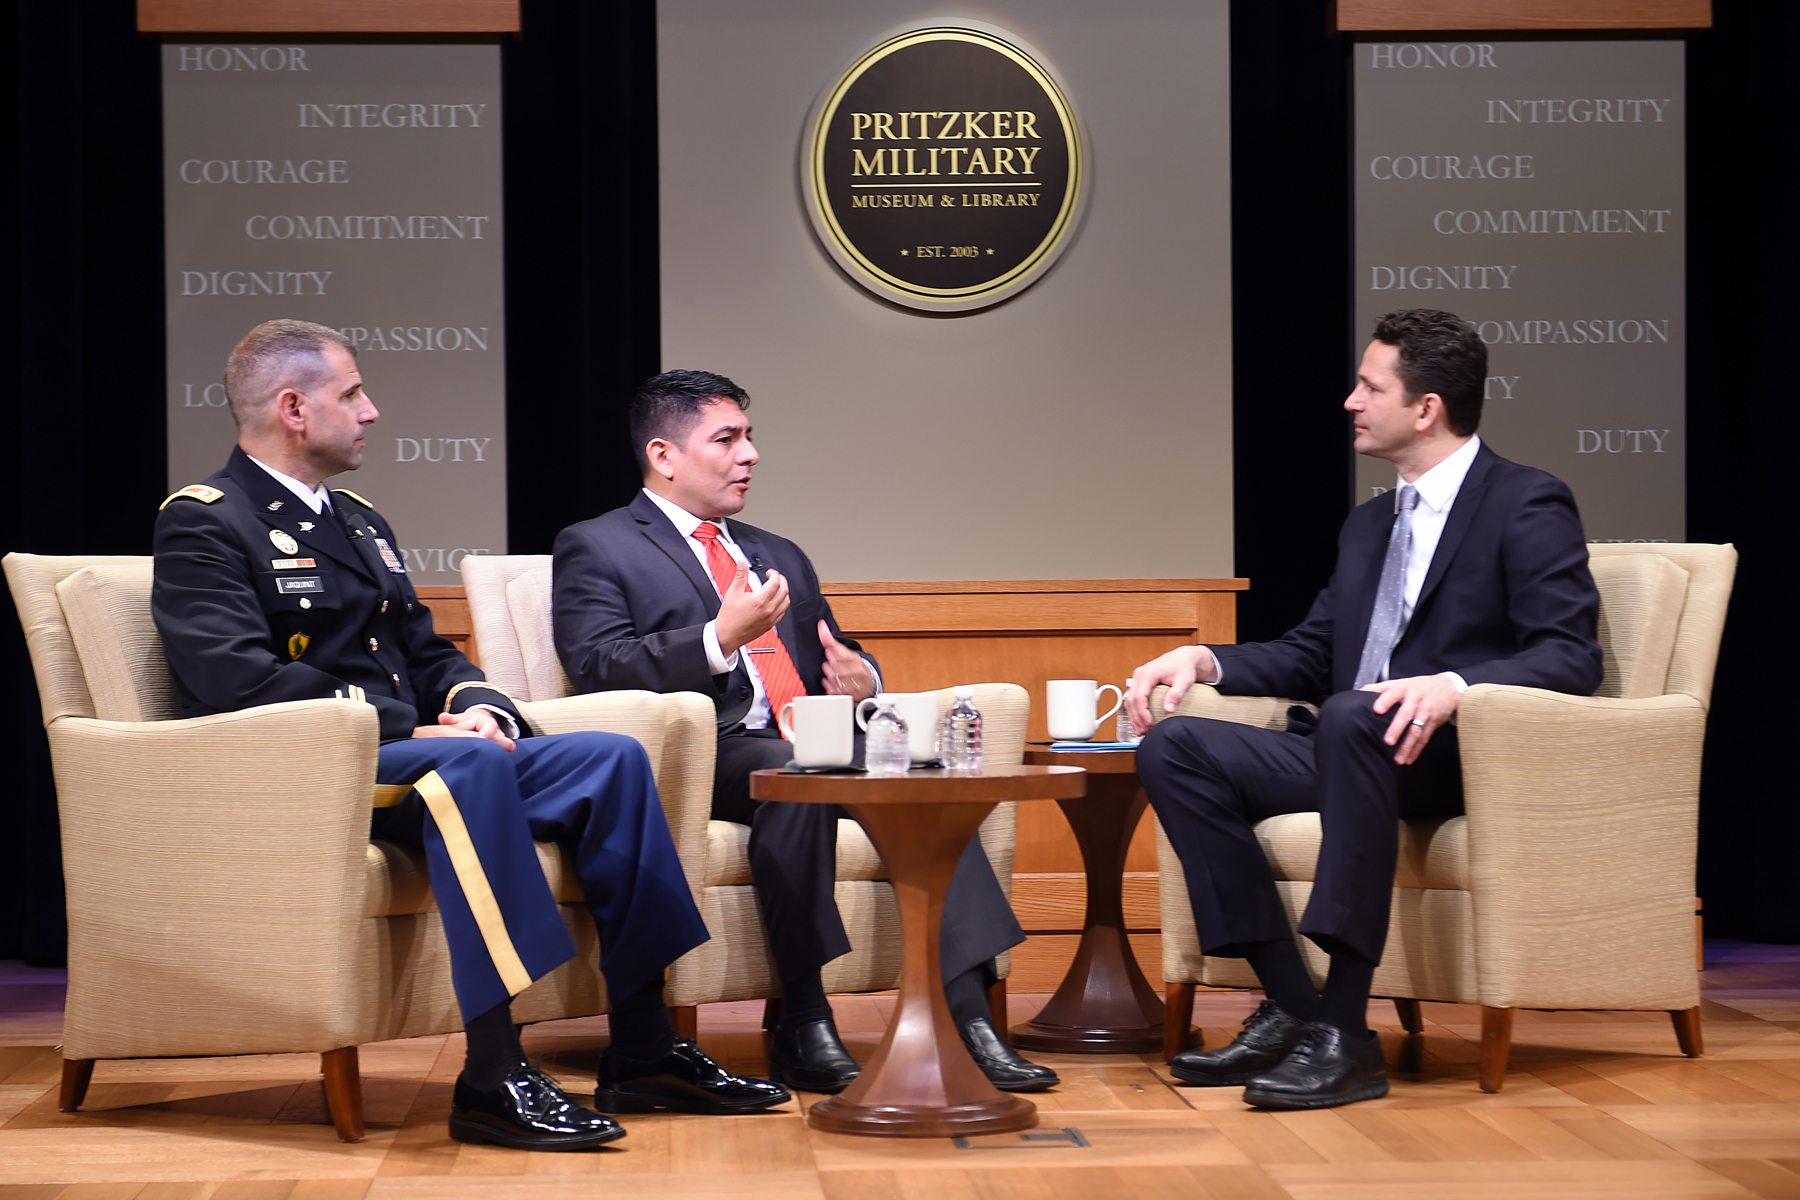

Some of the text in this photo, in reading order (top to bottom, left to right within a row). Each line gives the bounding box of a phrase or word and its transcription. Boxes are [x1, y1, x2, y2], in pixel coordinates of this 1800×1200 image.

[179, 47, 310, 71] HONOR
[1370, 44, 1498, 68] HONOR
[298, 103, 487, 128] INTEGRITY
[1486, 99, 1670, 123] INTEGRITY
[851, 111, 1042, 140] PRITZKER
[179, 159, 349, 184] COURAGE
[851, 147, 1042, 176] MILITARY
[1370, 155, 1535, 180] COURAGE
[852, 193, 1041, 208] MUSEUM & LIBRARY
[246, 215, 488, 240] COMMITMENT
[1433, 209, 1670, 234] COMMITMENT
[916, 245, 979, 258] EST. 2003
[181, 271, 332, 296] DIGNITY
[1370, 265, 1517, 290] DIGNITY
[1467, 319, 1669, 344] OMPASSION
[395, 437, 491, 462] DUTY
[1577, 429, 1670, 453] DUTY
